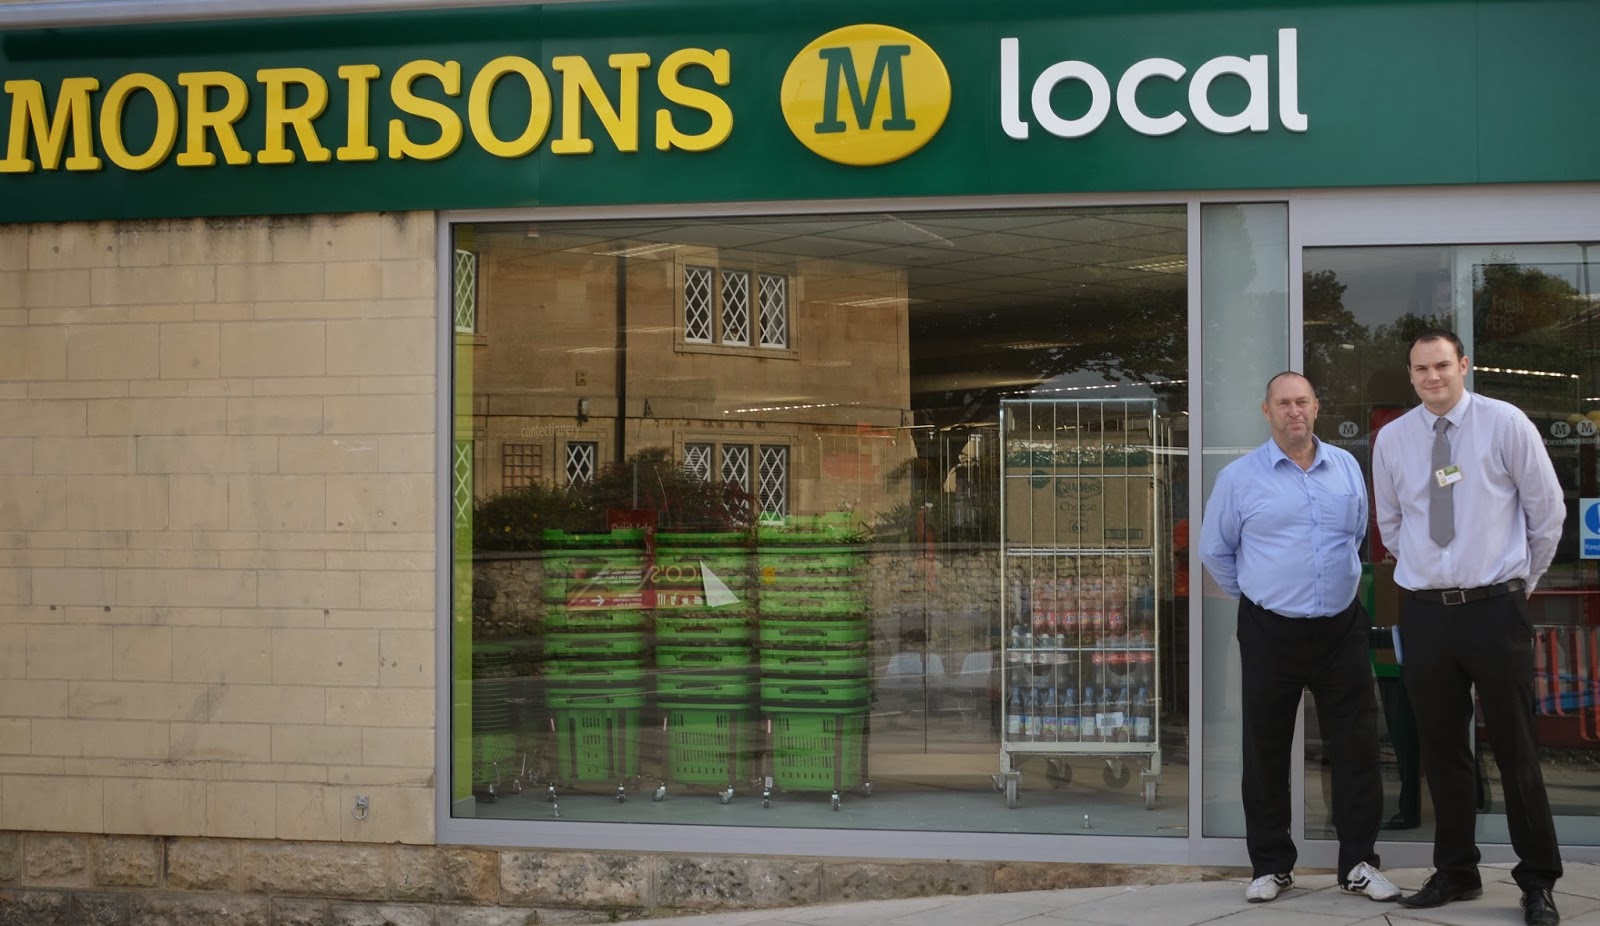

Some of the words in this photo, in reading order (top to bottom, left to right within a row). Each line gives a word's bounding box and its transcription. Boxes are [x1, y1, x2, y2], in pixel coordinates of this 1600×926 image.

[0, 48, 733, 172] MORRISONS
[814, 45, 916, 134] M
[1001, 28, 1307, 139] local
[521, 422, 580, 438] confectionery
[1057, 481, 1100, 494] Quavers
[1060, 502, 1097, 512] Cheese
